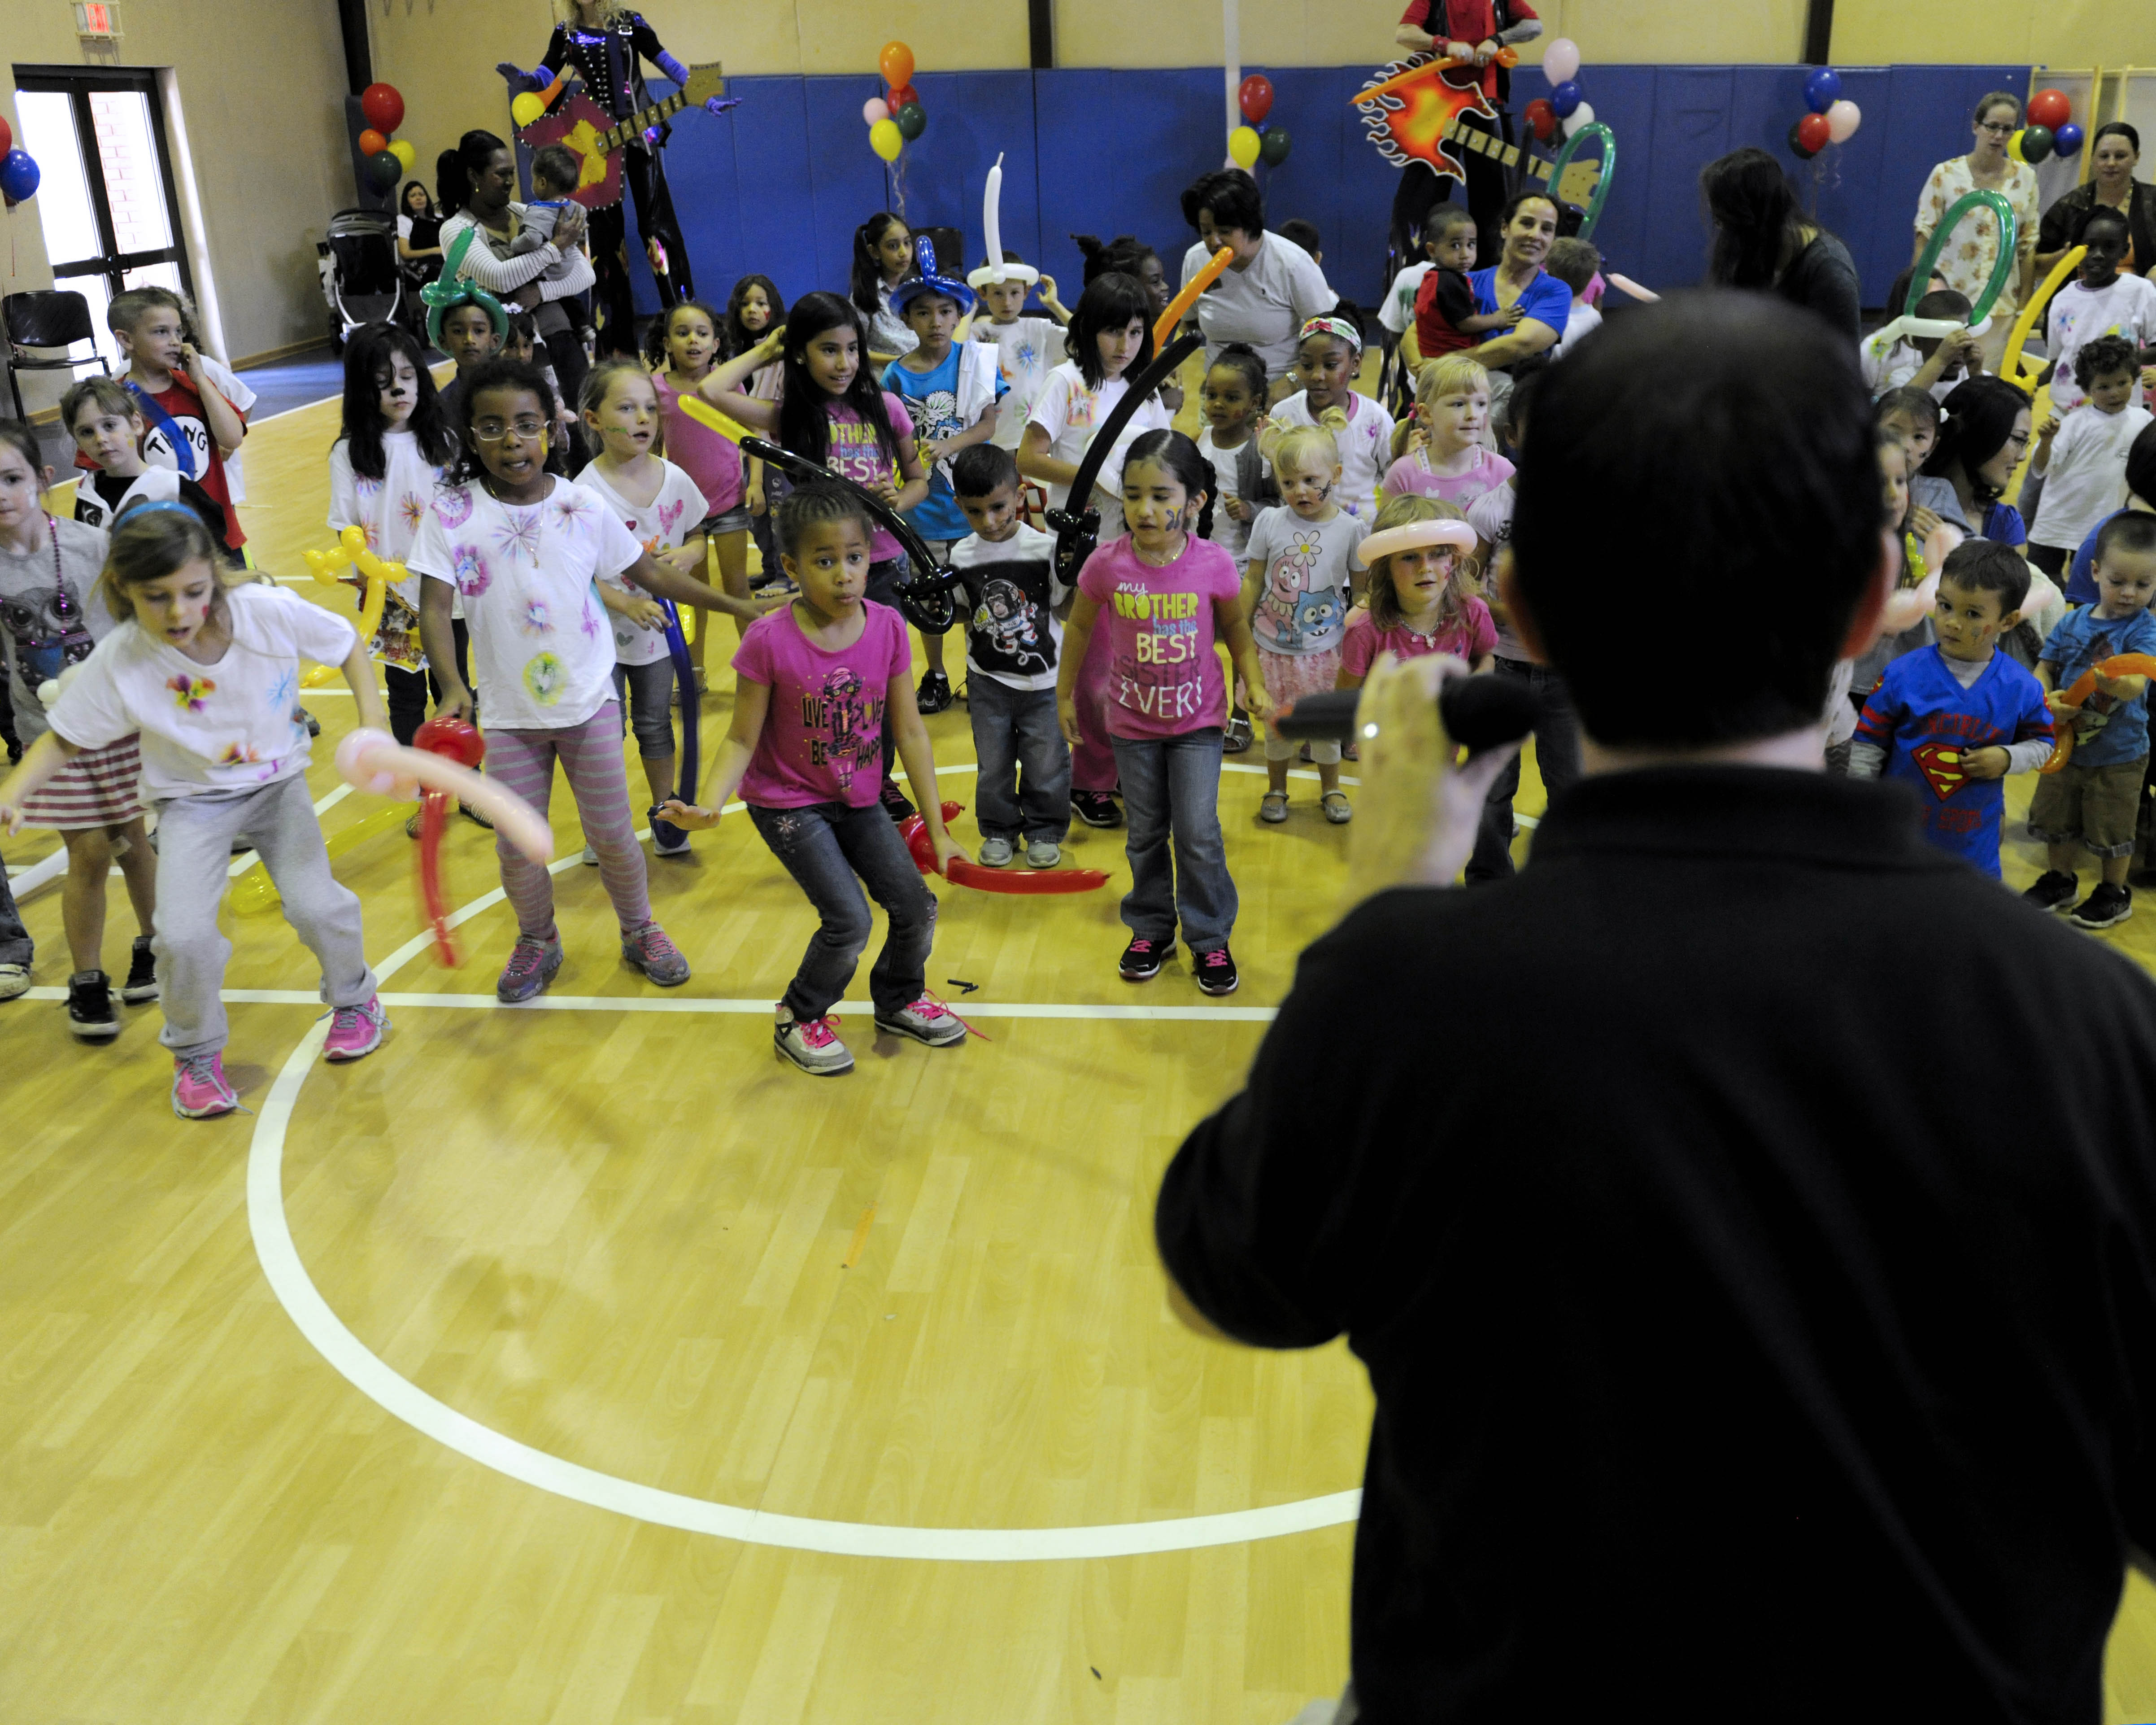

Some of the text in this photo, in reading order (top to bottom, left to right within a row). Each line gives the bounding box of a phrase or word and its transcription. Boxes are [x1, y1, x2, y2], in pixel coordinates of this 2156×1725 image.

[147, 425, 208, 454] THNG
[829, 423, 878, 444] OTHER
[827, 456, 881, 481] BEST
[1114, 592, 1198, 619] BROTHER
[1116, 581, 1148, 606] my
[1153, 614, 1198, 637] has the
[1137, 629, 1198, 664] BEST
[1119, 655, 1202, 688] SISTER
[1119, 675, 1202, 718] EVER!
[802, 696, 829, 728] LIVE
[811, 737, 882, 771] BE HAPP
